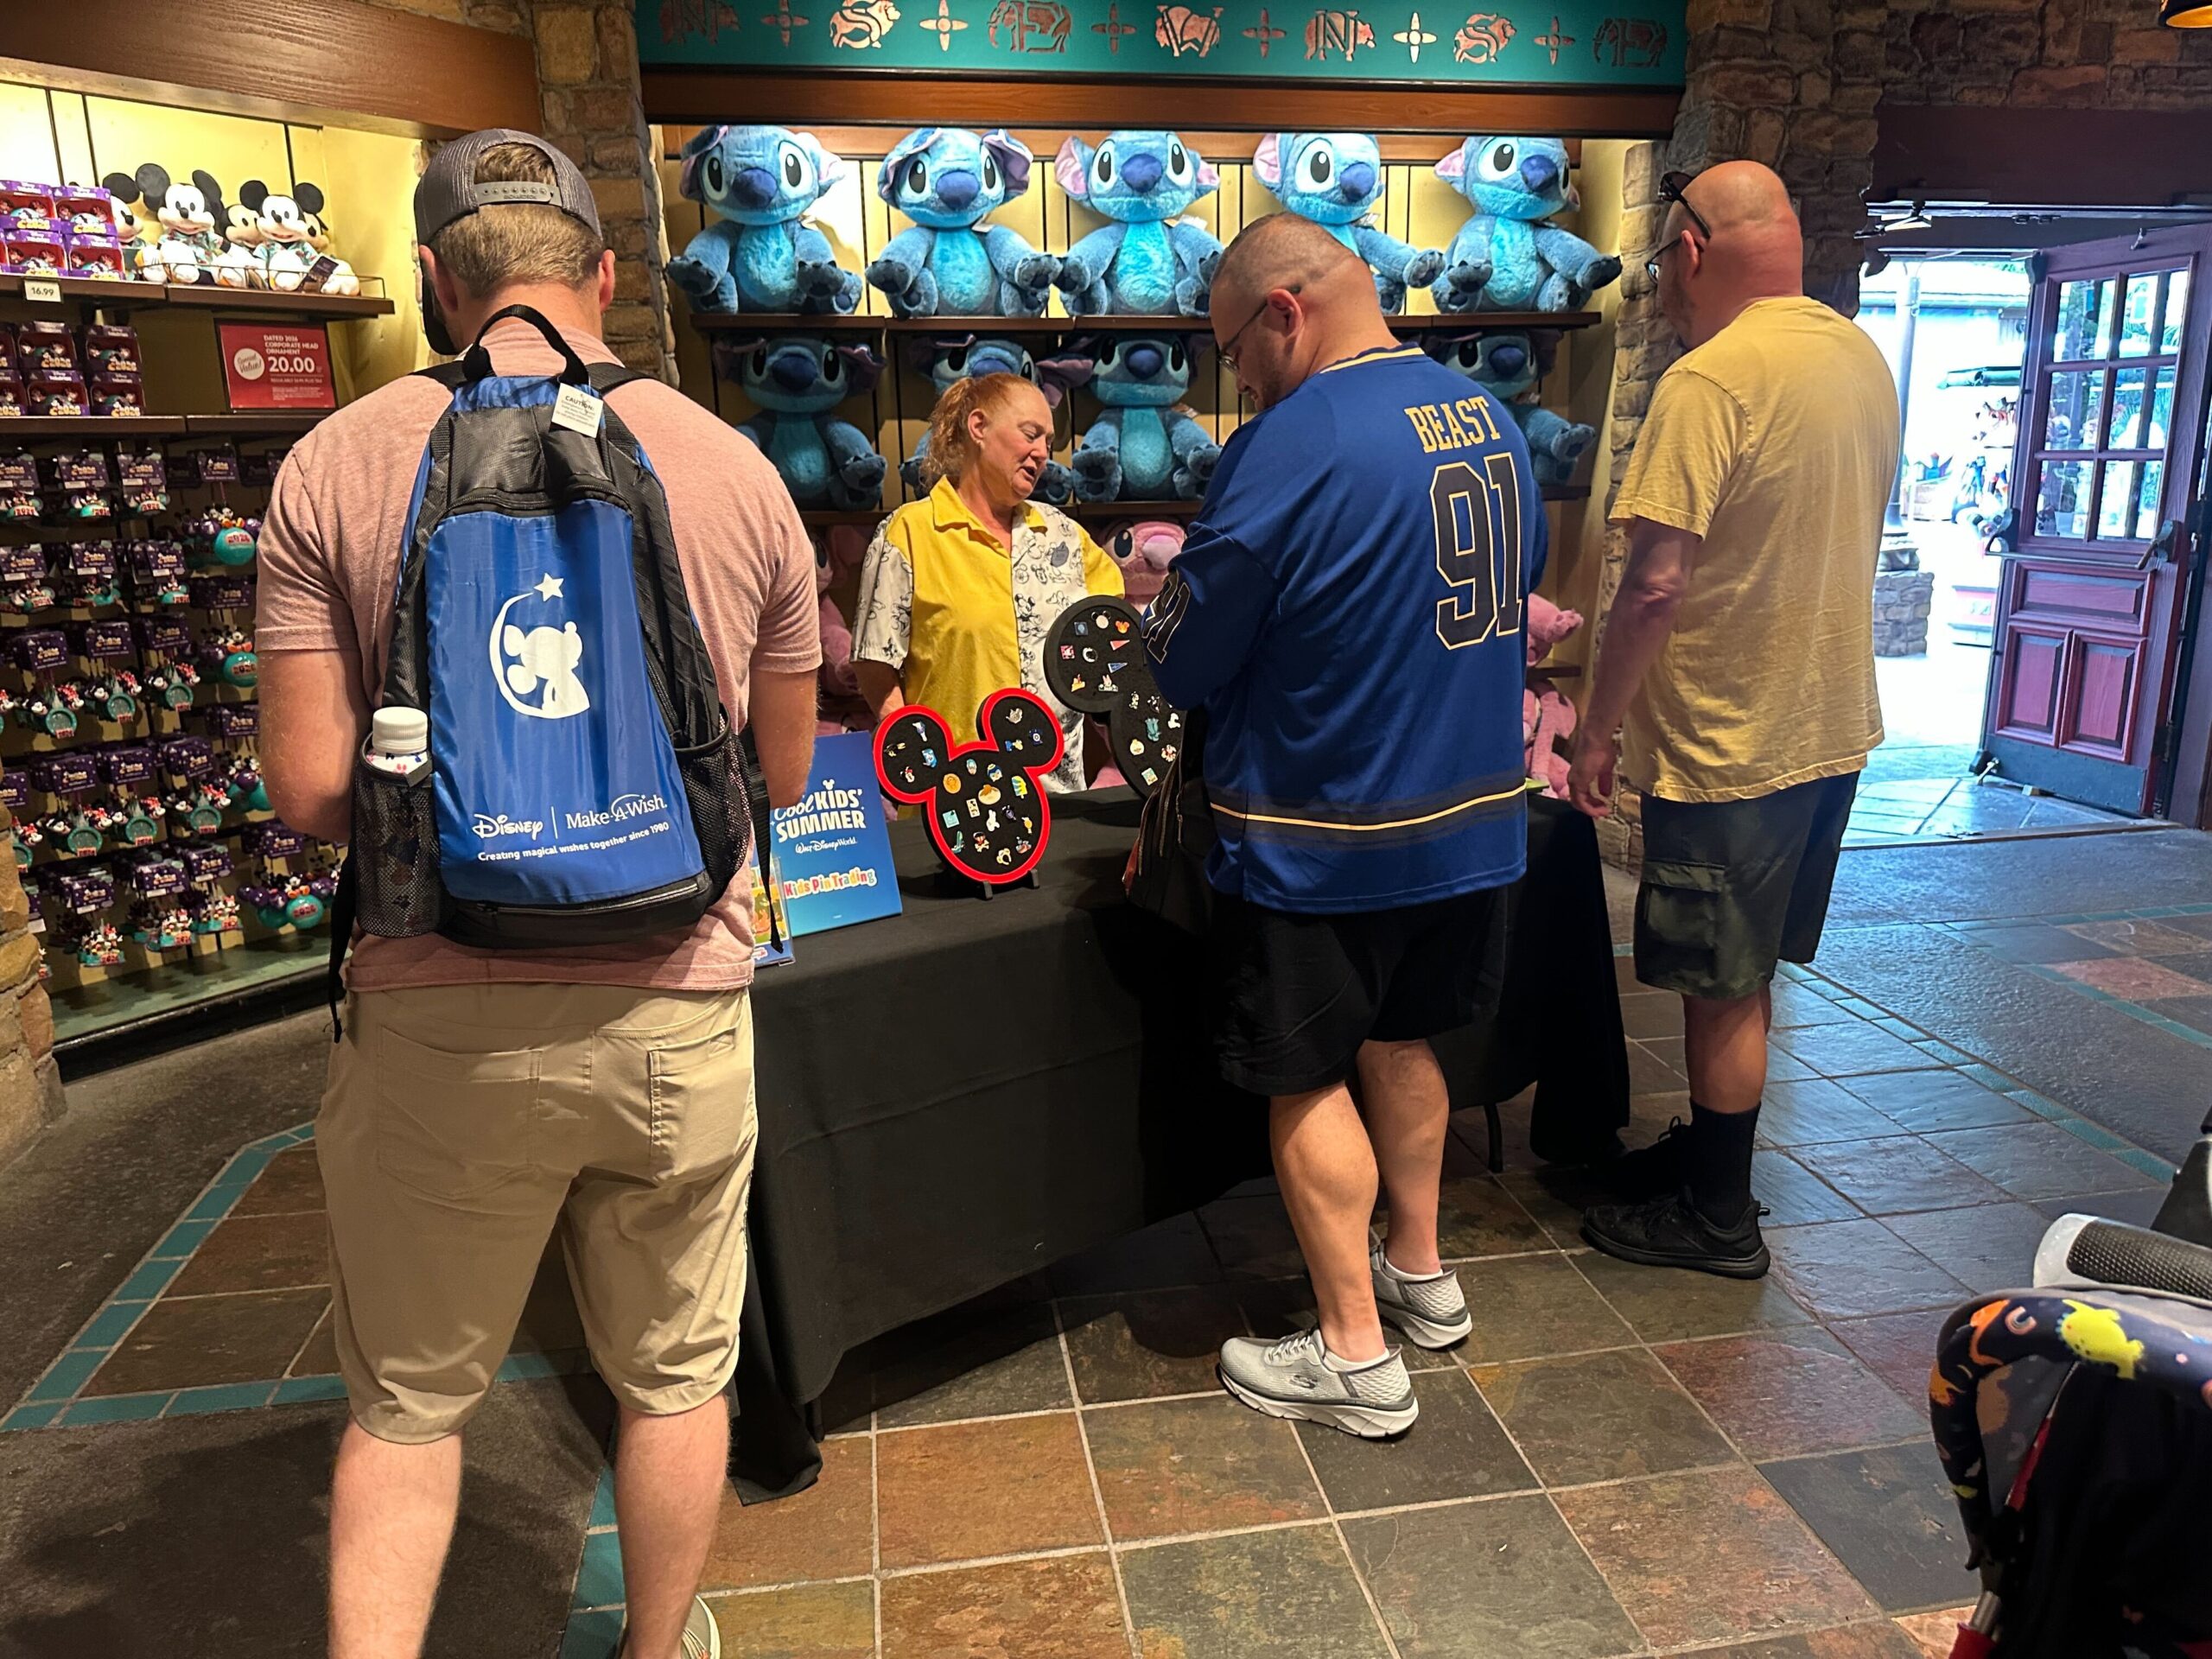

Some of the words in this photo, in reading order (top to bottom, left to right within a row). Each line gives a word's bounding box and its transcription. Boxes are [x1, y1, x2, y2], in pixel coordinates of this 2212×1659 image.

[31, 287, 54, 296] 16.99
[268, 356, 315, 372] 20.00
[1404, 396, 1501, 454] BEAST
[1430, 452, 1522, 650] 91
[774, 794, 814, 820] Cool
[478, 851, 520, 861] Creating
[522, 845, 558, 858] magical
[559, 842, 589, 854] wishes
[589, 836, 627, 849] together
[628, 830, 650, 841] since
[649, 822, 670, 834] 1980
[776, 810, 866, 843] SUMMER
[784, 880, 811, 898] Kids
[811, 875, 830, 893] Pin
[830, 868, 876, 887] Trading
